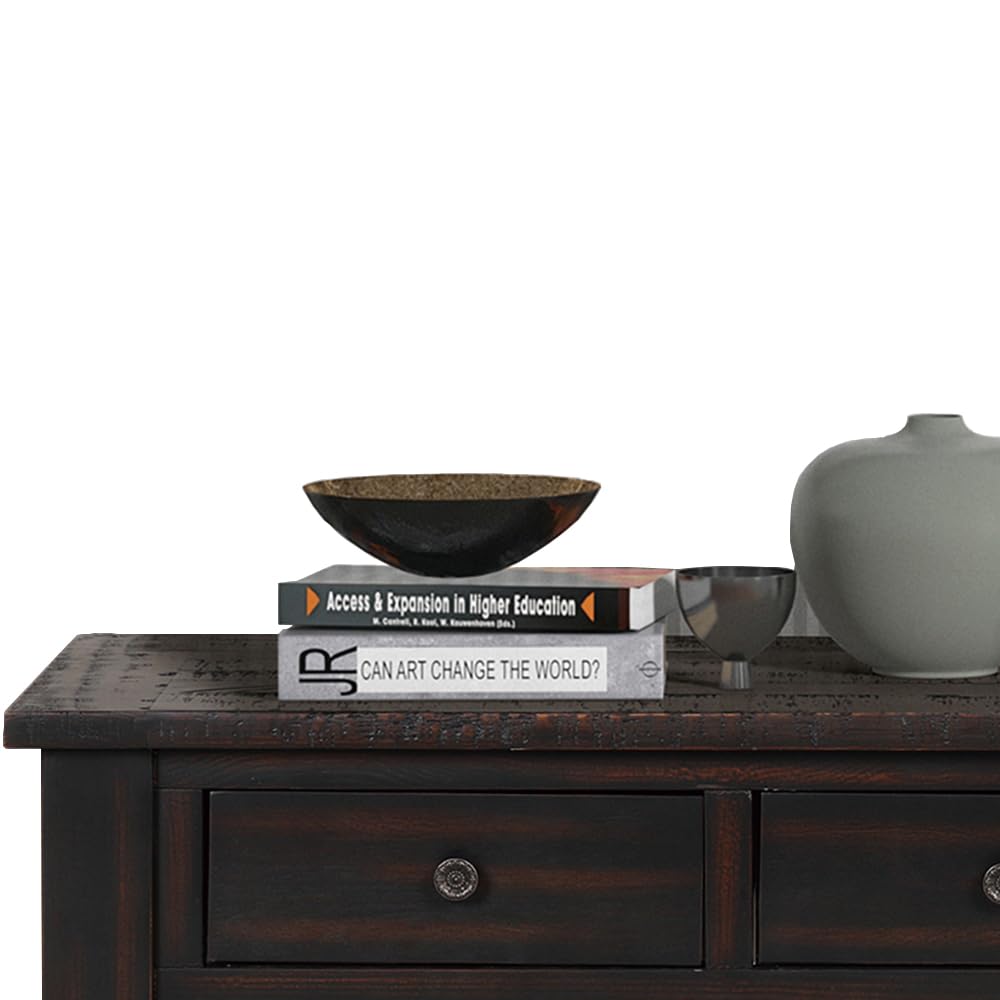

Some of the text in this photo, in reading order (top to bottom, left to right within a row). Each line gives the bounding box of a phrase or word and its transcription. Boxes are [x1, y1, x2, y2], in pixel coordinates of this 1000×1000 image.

[326, 591, 576, 619] Access & Expansion in Higher Education
[299, 645, 358, 696] JR
[361, 658, 601, 681] CAN ART CHANGE THE WORLD?
